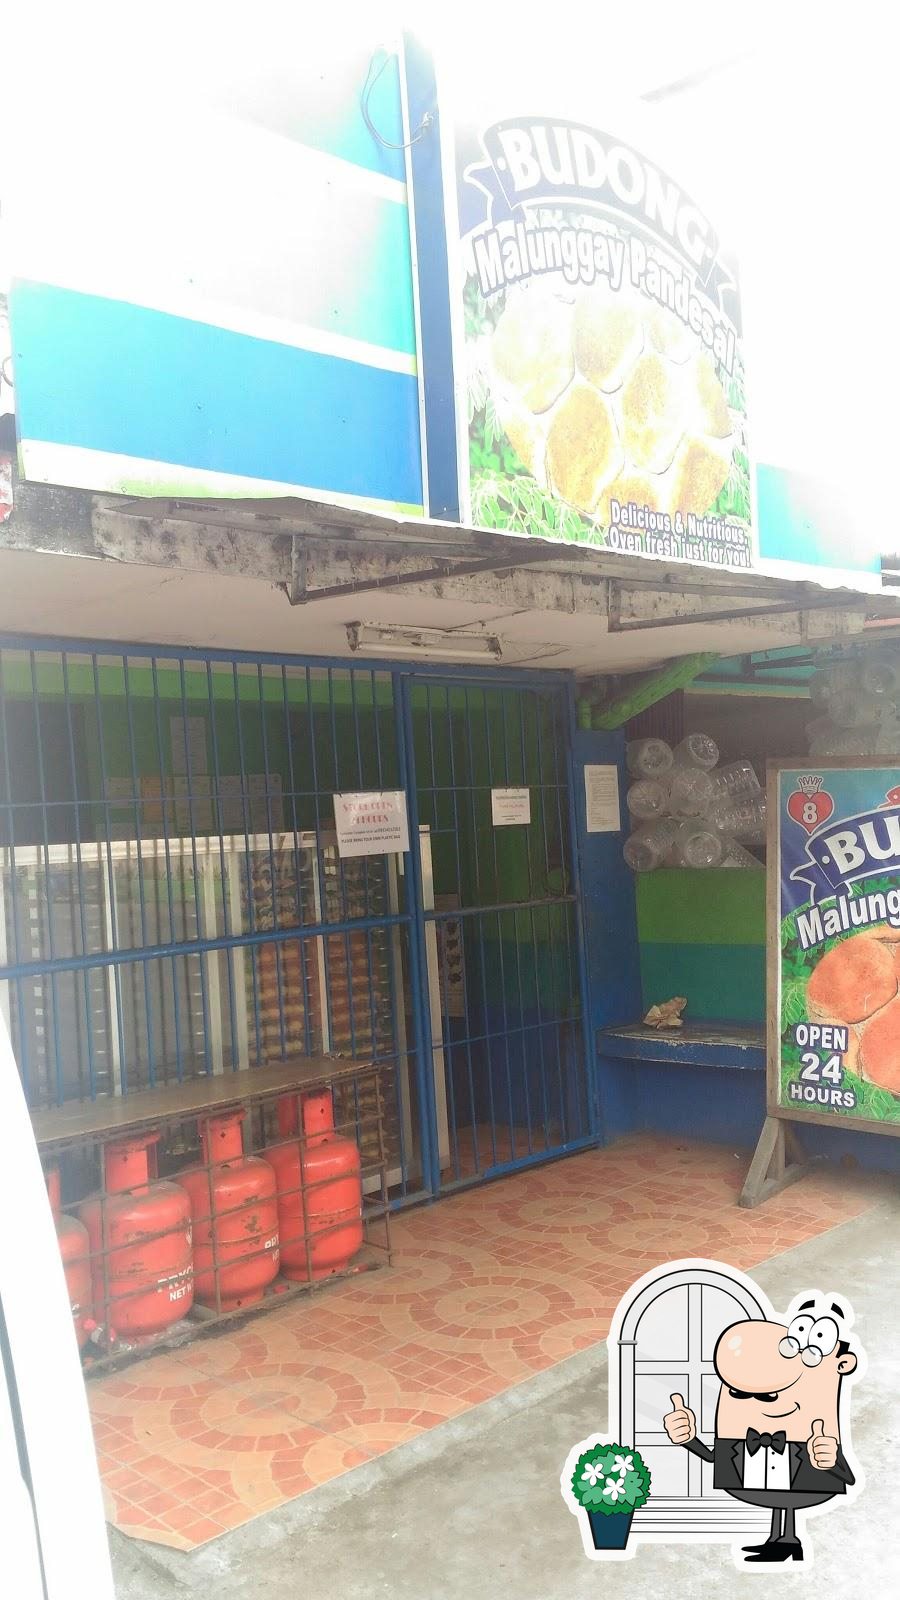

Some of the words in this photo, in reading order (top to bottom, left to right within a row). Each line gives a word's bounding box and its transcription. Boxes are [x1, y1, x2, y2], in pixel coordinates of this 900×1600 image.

[473, 222, 625, 297] Malunggay
[629, 234, 736, 377] Pandesal
[611, 500, 671, 532] Delicious
[675, 511, 684, 534] &
[609, 526, 641, 552] Oven
[645, 532, 678, 557] fresh
[681, 539, 706, 562] just
[708, 543, 724, 563] for
[802, 802, 818, 824] 8
[795, 1024, 846, 1051] OPEN
[801, 1053, 842, 1084] 24
[790, 1084, 855, 1107] HOURS
